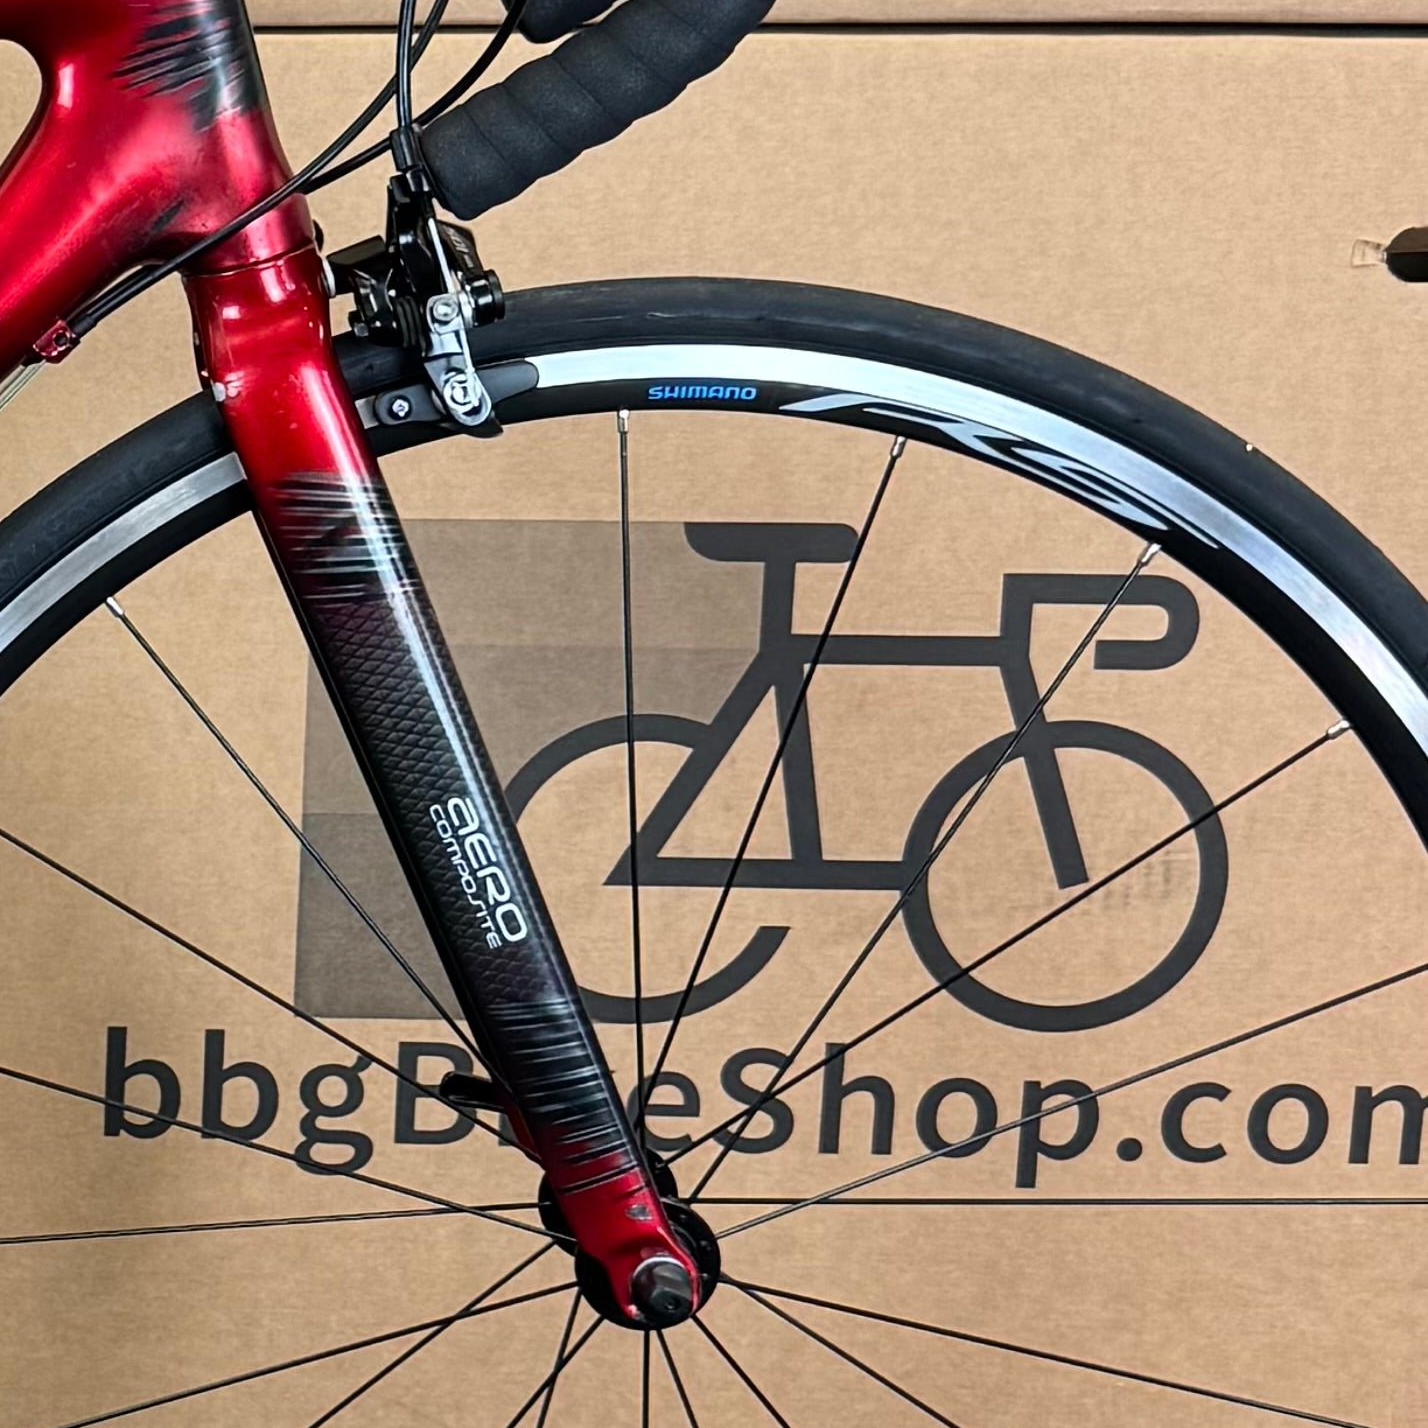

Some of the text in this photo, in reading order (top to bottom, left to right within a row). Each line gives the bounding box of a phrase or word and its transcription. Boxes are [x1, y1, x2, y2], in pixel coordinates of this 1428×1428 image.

[648, 385, 757, 400] SHIMANO
[430, 804, 502, 949] COMPOSITE
[447, 797, 528, 943] AERO
[102, 1026, 1428, 1189] bbgBeShop.com
